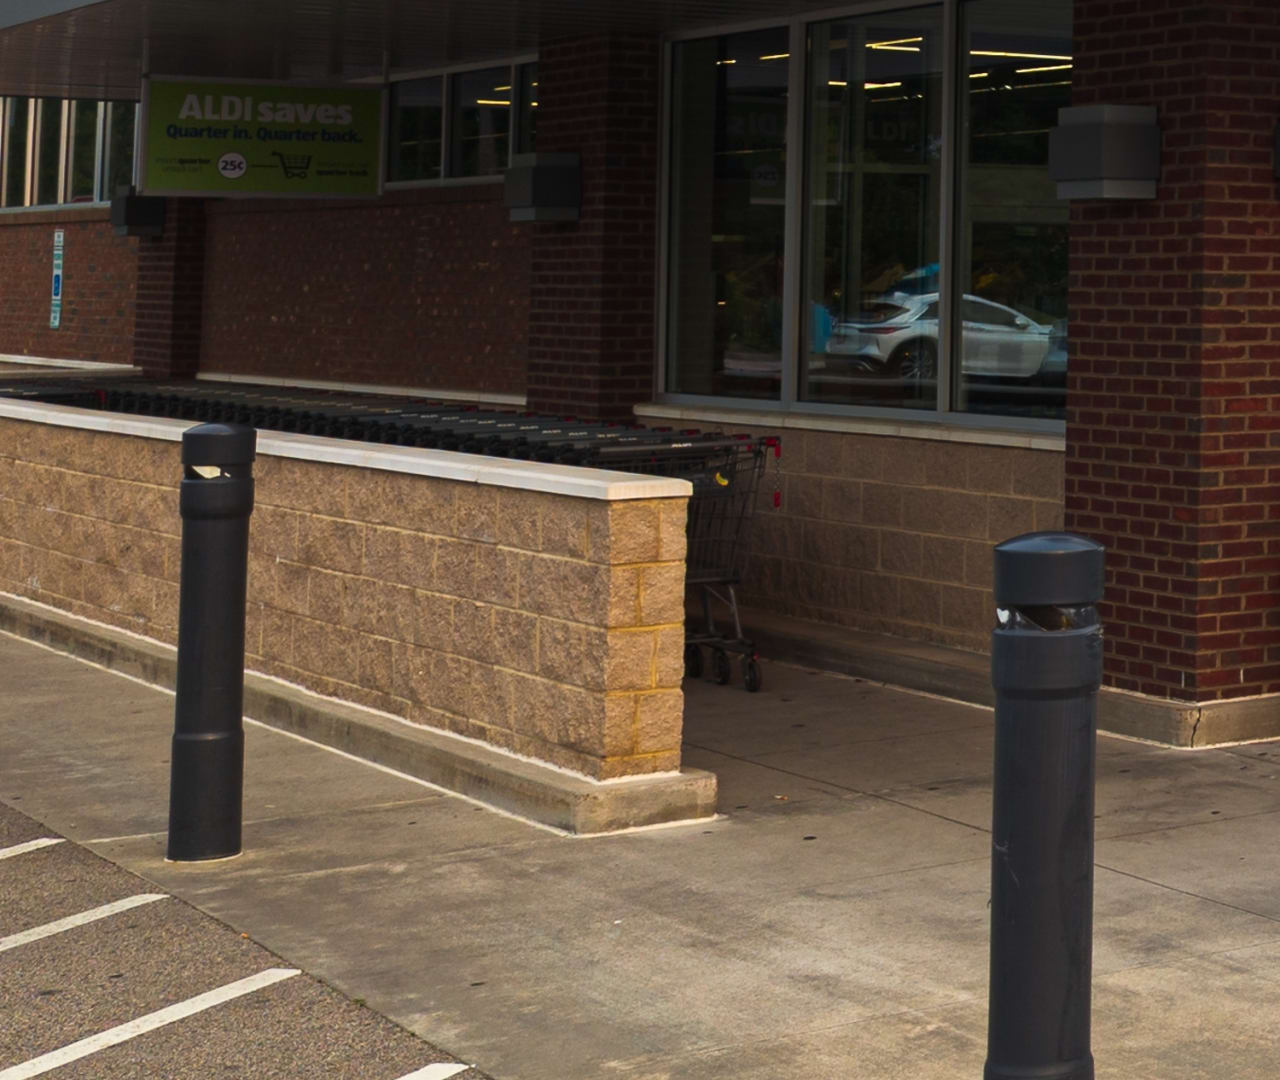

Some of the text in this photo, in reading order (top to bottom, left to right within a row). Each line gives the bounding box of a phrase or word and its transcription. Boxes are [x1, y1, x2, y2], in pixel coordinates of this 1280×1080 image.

[178, 93, 353, 125] ALDI saves
[166, 123, 363, 144] Quarter in. Quarter back.
[220, 160, 244, 172] 25¢
